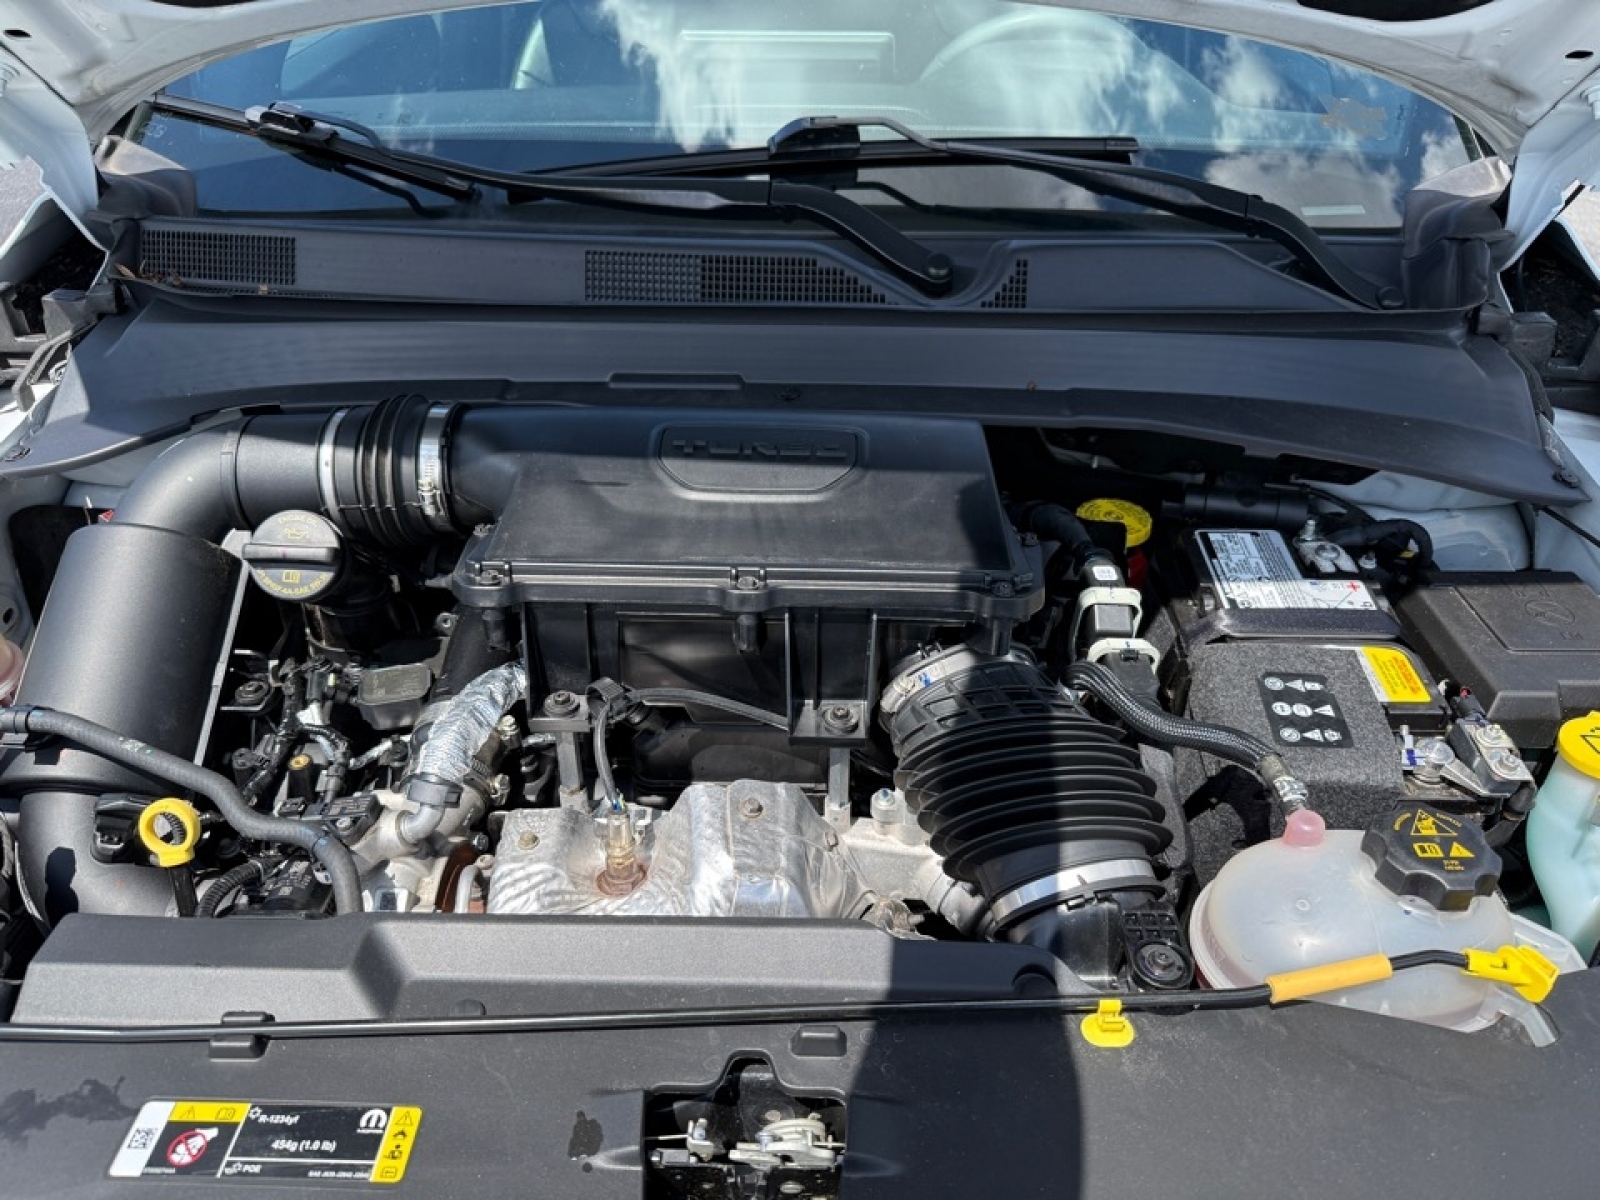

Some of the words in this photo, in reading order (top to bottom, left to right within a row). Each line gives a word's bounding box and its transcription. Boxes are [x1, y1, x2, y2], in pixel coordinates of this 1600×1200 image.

[271, 1139, 298, 1152] 454g
[300, 1140, 320, 1152] (1.0
[321, 1140, 337, 1152] lb)
[242, 1164, 262, 1174] POE
